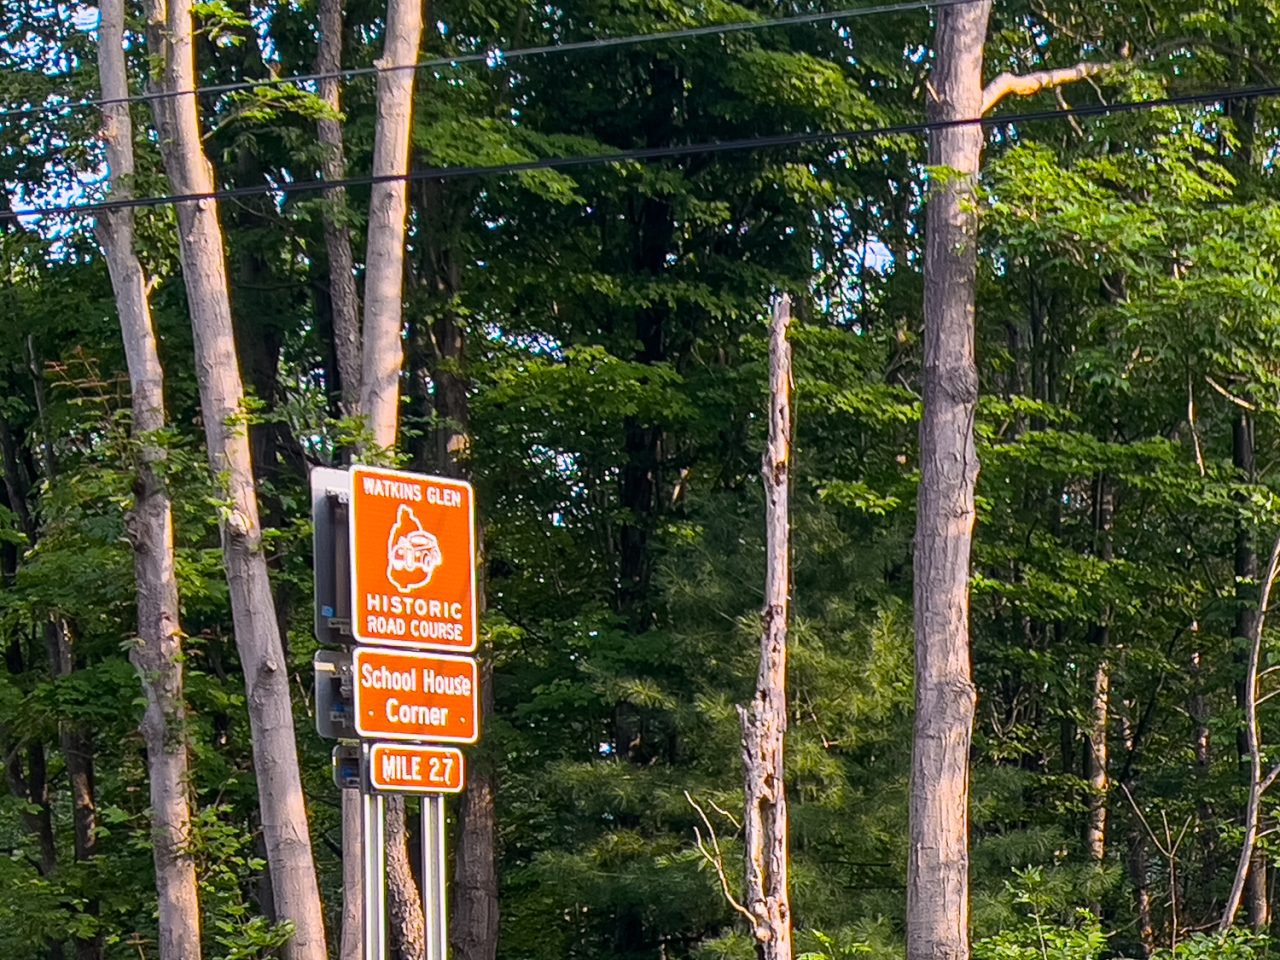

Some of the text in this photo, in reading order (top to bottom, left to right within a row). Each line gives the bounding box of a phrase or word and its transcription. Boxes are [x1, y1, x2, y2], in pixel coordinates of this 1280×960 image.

[362, 477, 462, 508] WATKINS GLEN
[366, 593, 463, 620] HISTORIC
[367, 615, 464, 642] ROAD COURSE
[361, 662, 471, 697] School House
[385, 697, 449, 727] Corner
[381, 754, 422, 782] MILE
